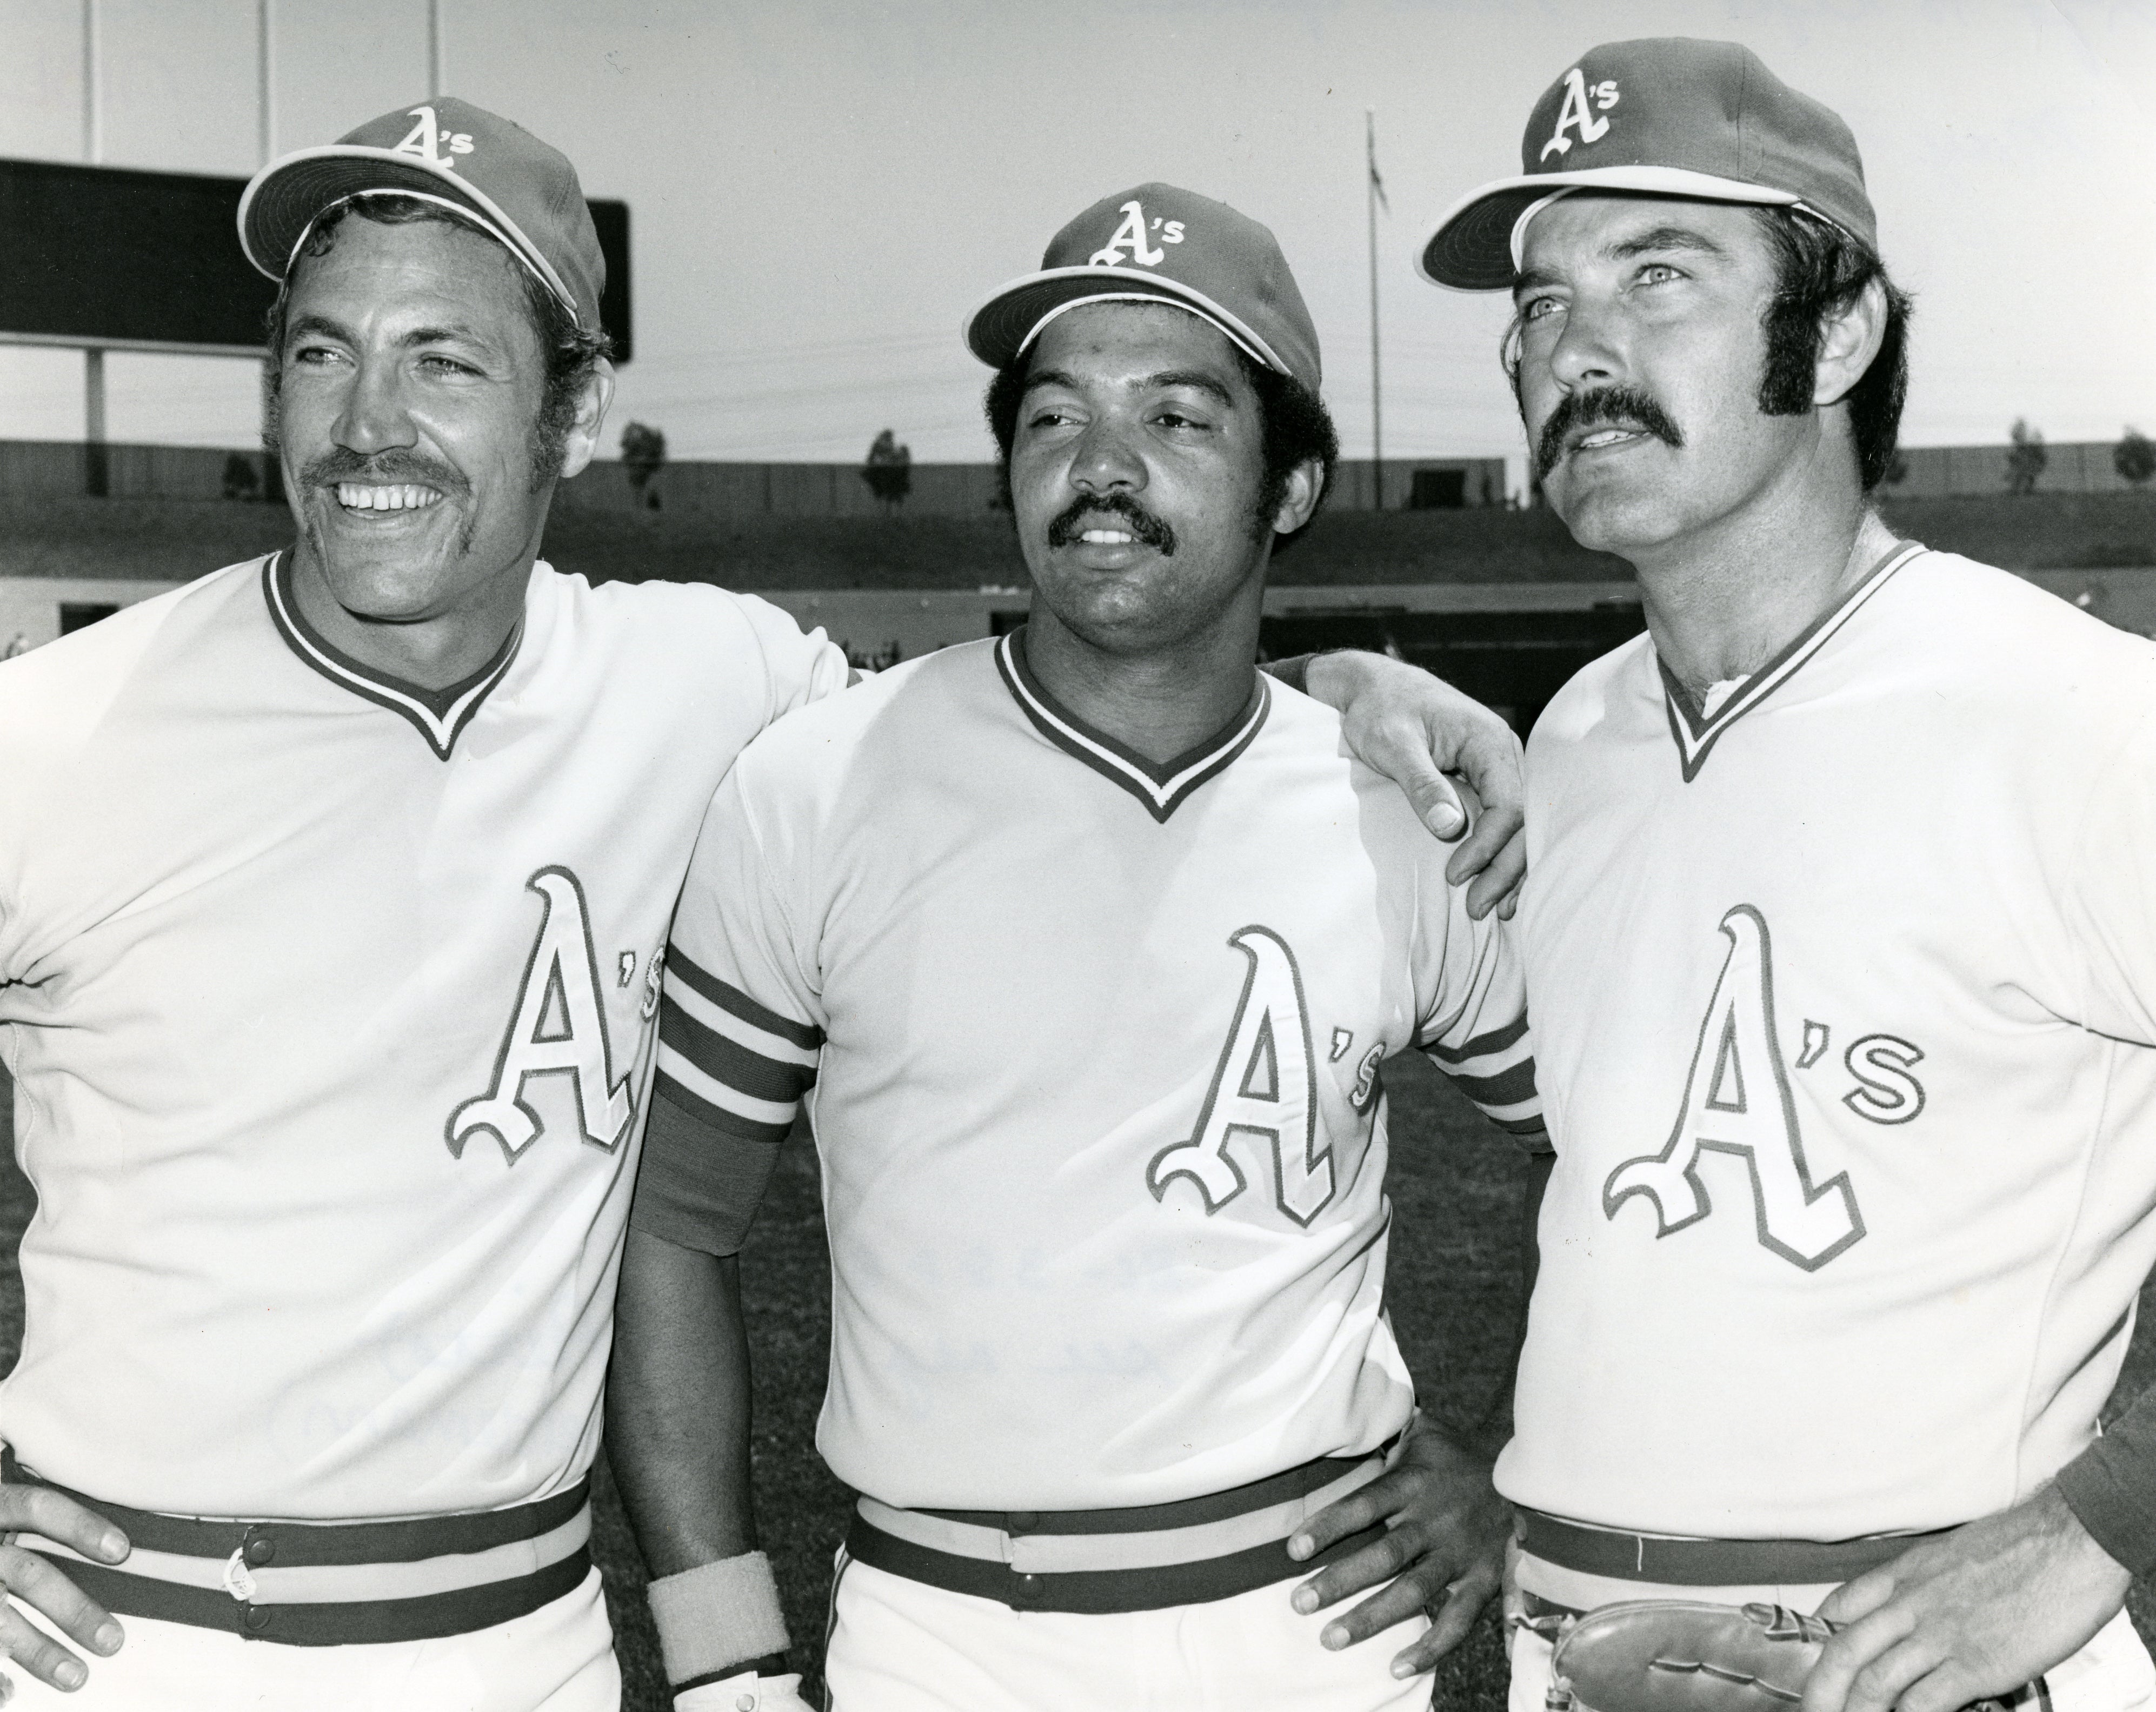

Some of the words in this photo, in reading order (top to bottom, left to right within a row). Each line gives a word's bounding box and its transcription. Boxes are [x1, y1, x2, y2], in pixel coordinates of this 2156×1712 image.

[390, 106, 475, 168] A's
[1541, 68, 1619, 162] A's
[1088, 200, 1186, 267] A's
[444, 864, 666, 1167] A's
[1145, 924, 1387, 1229] A's
[1602, 903, 1926, 1272] A's
